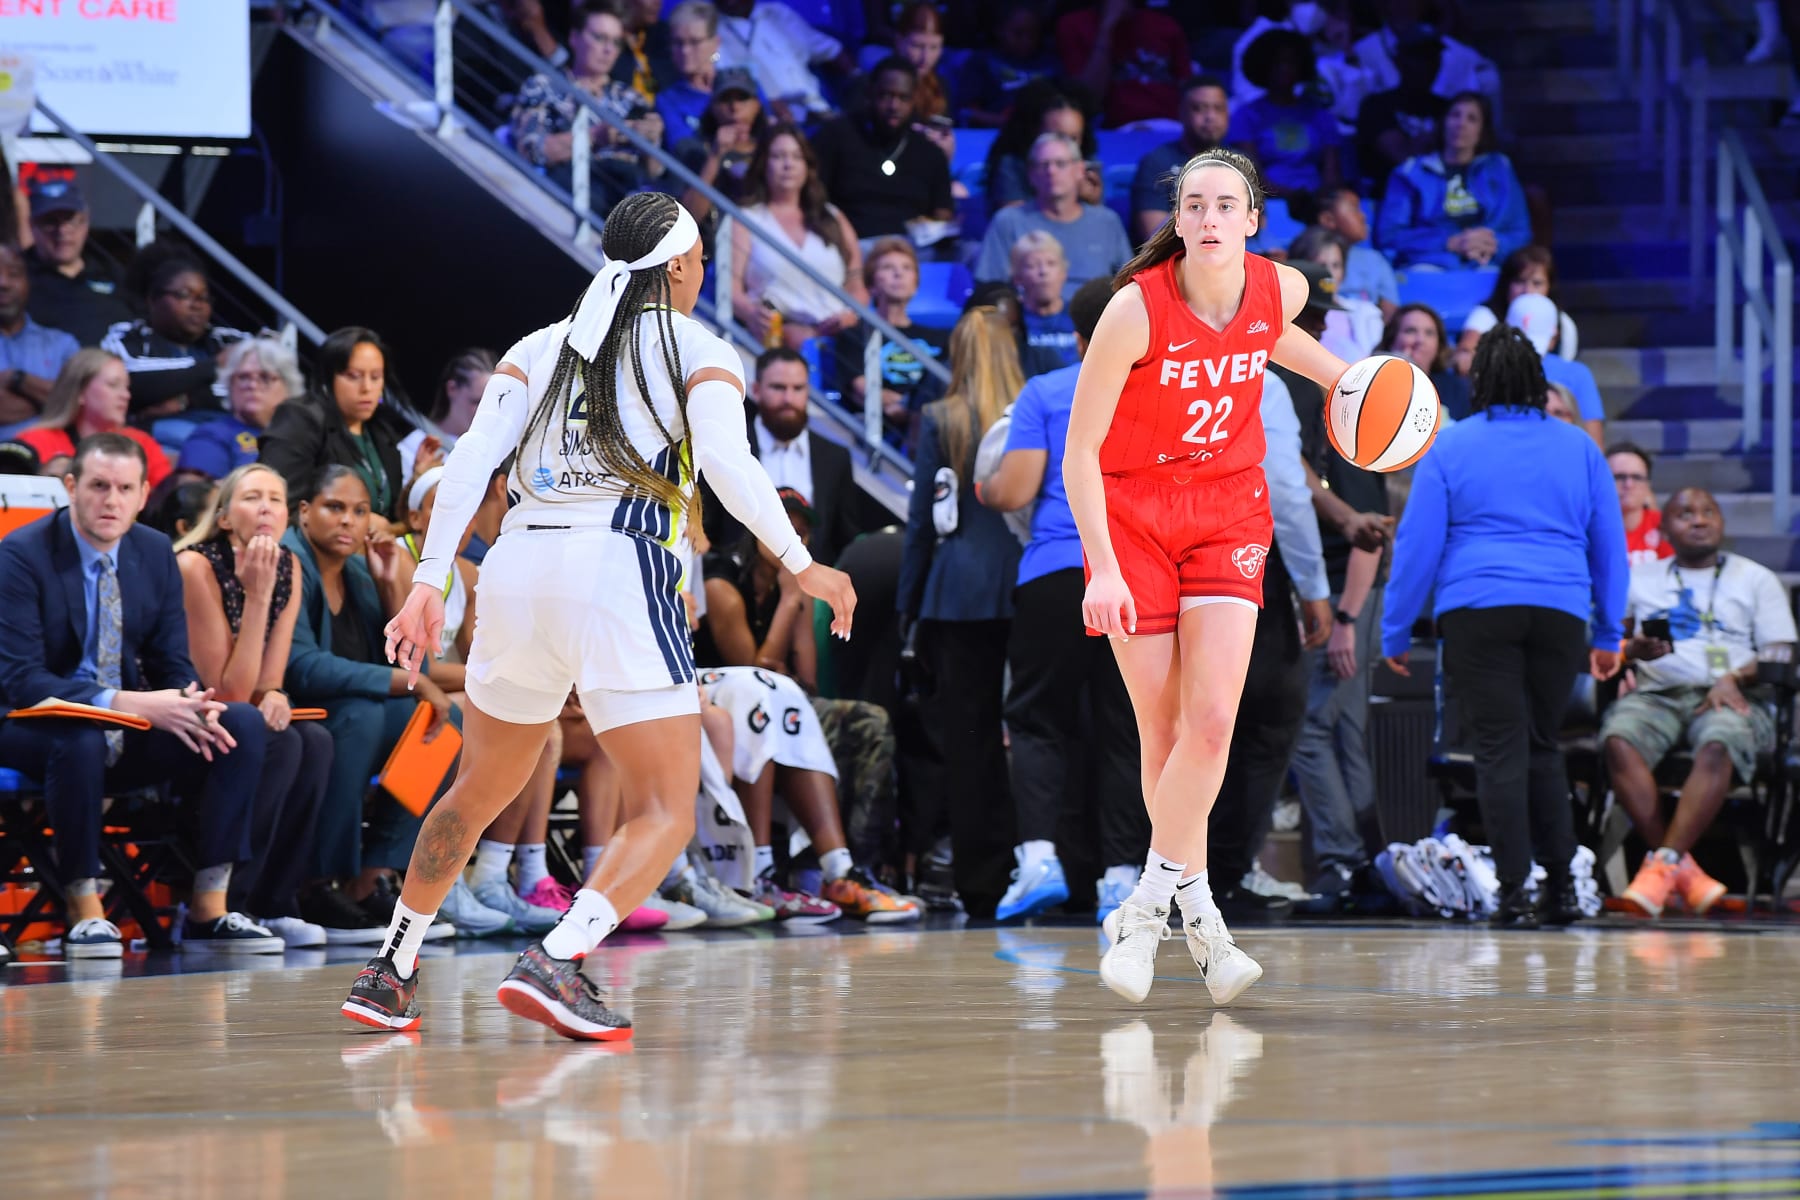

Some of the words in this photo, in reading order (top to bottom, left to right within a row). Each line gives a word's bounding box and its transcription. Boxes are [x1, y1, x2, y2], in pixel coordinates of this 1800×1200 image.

[78, 0, 178, 22] CARE
[1247, 320, 1270, 334] Lilly
[1160, 349, 1268, 389] FEVER
[1182, 395, 1233, 444] 22
[783, 707, 800, 735] G
